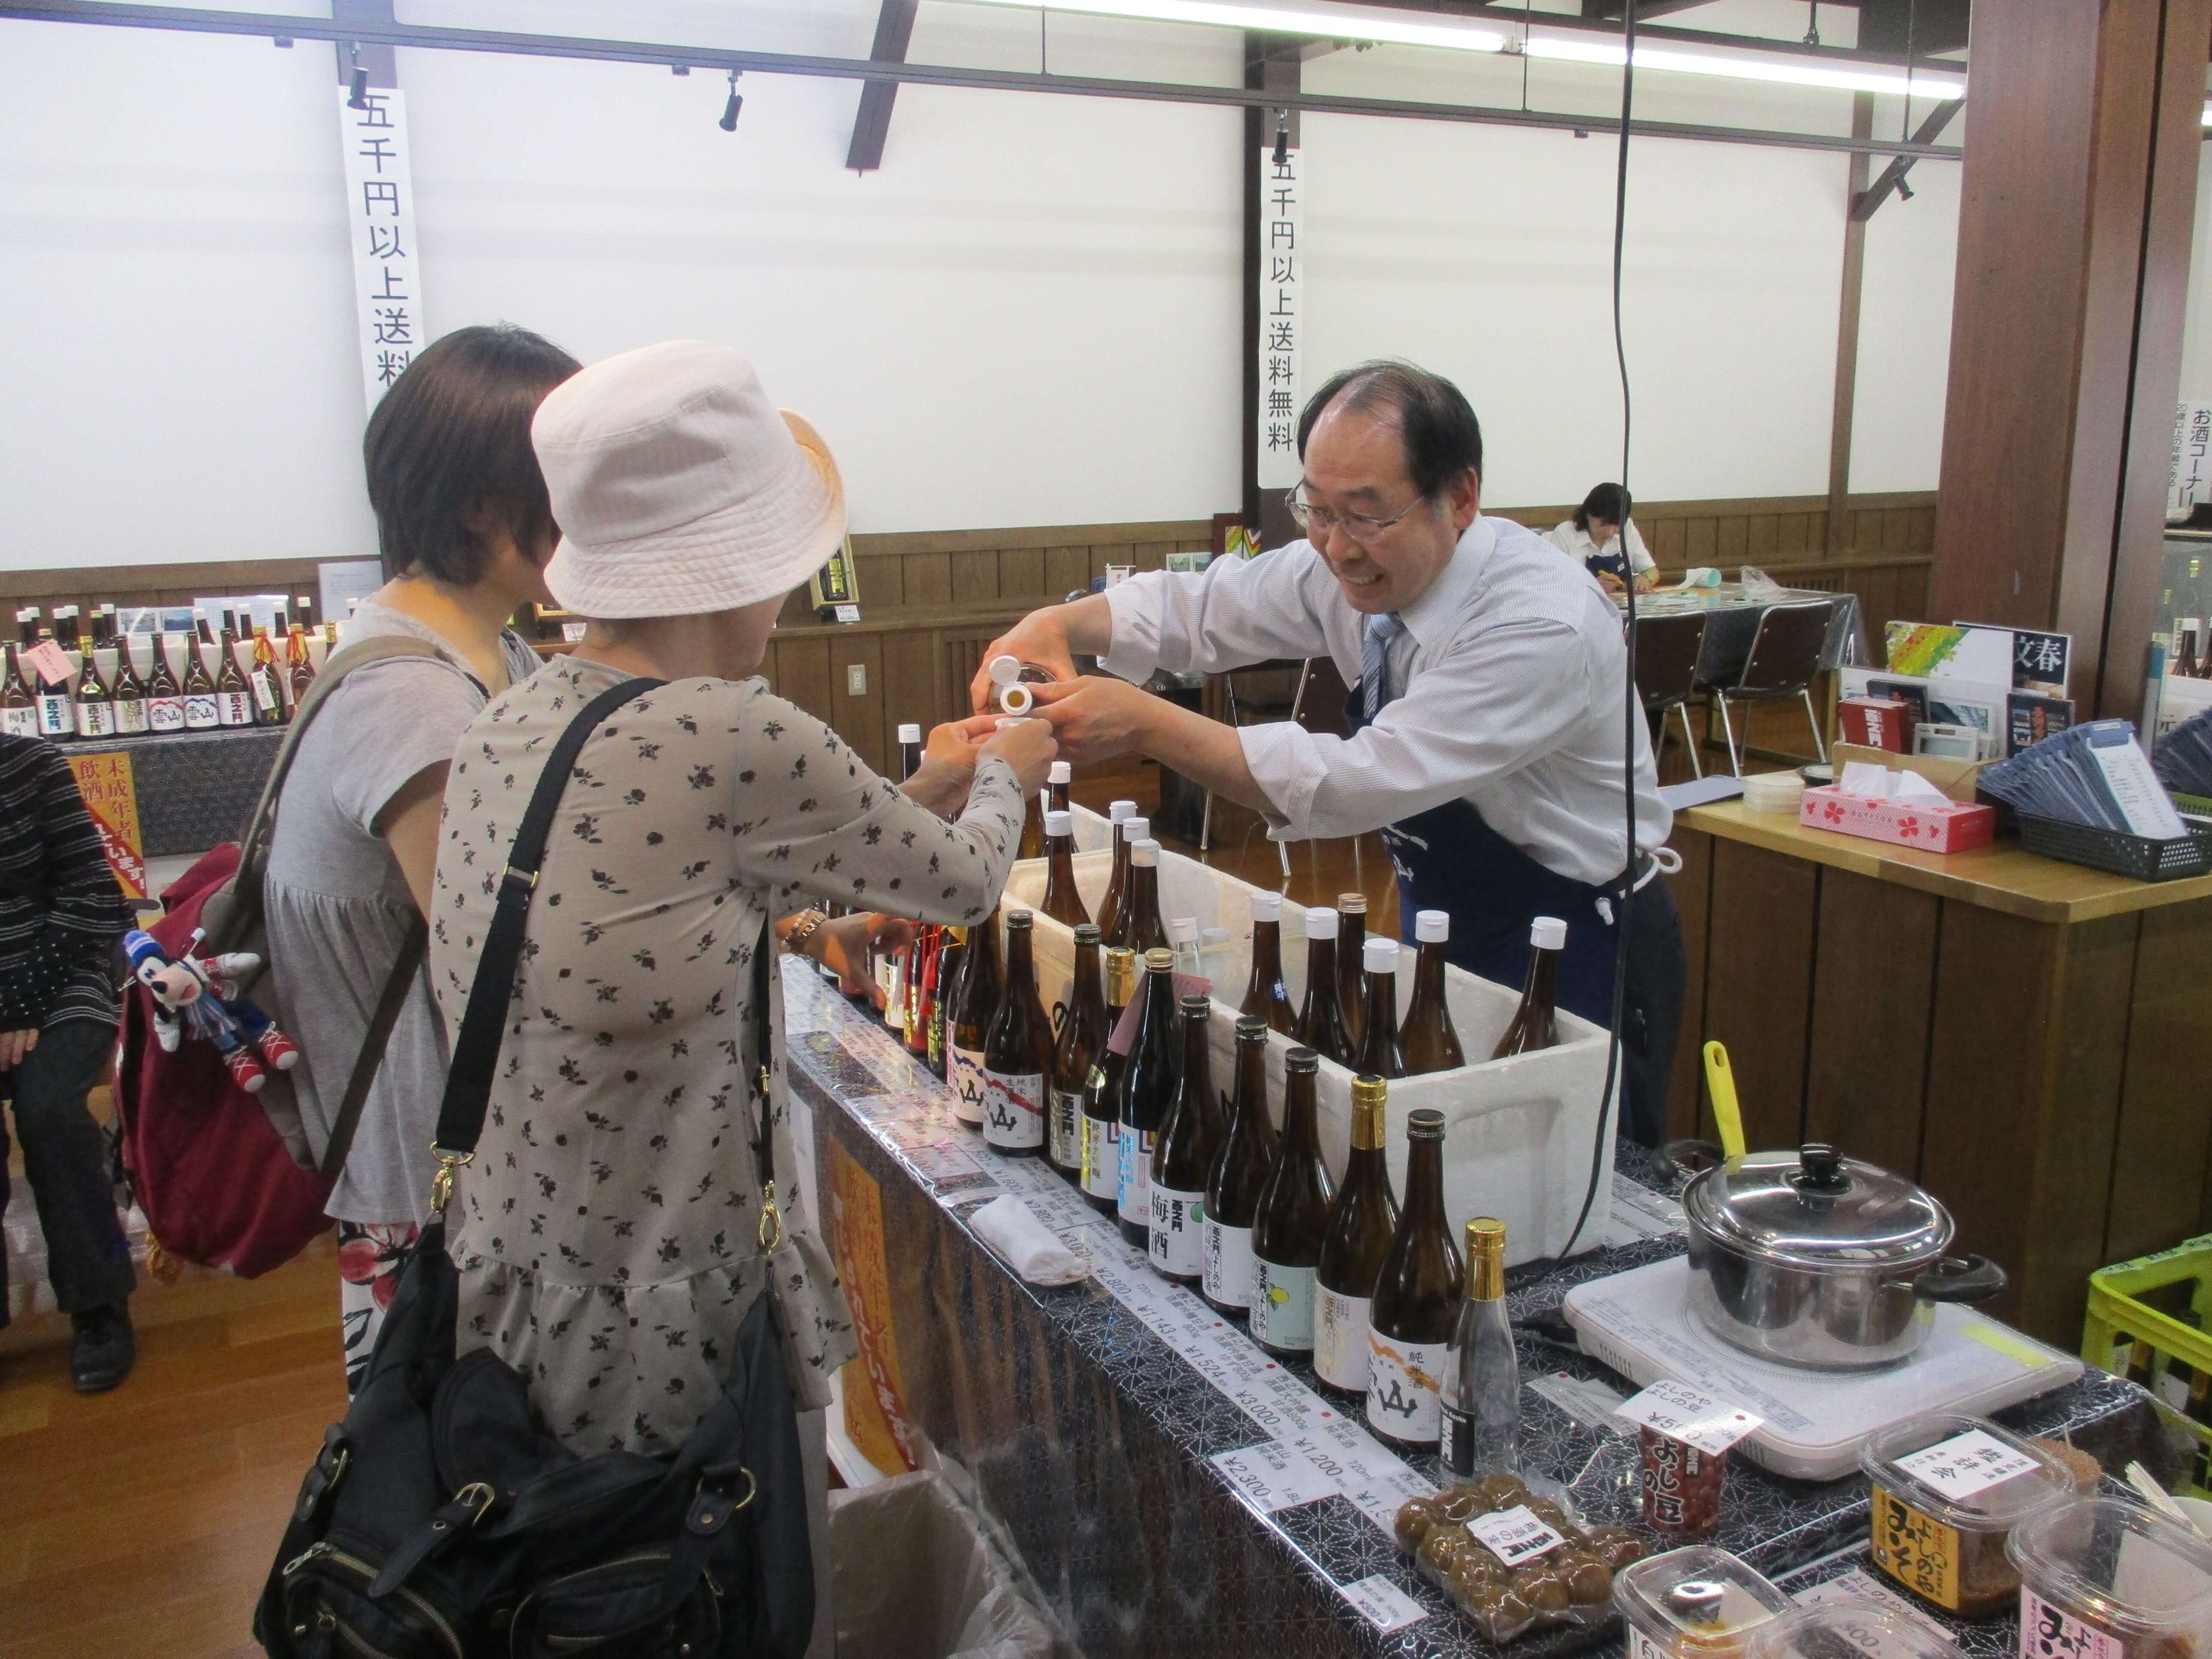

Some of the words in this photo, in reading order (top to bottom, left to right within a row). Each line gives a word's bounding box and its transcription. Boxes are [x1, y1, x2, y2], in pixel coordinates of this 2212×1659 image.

[1267, 154, 1296, 452] 五千円以上送料無料
[2185, 409, 2211, 507] お酒コーナー
[80, 760, 104, 802] 飲酒
[109, 759, 133, 839] 未成年者
[1152, 1191, 1169, 1259] 梅酒
[1177, 1292, 1205, 1310] 西之門
[1224, 1331, 1254, 1352] 西之門
[1408, 1351, 1425, 1389] 純米酒
[1276, 1374, 1308, 1396] 西之門
[1656, 1381, 1711, 1405] よしのや
[1646, 1388, 1704, 1413] よしの豆
[1324, 1425, 1357, 1449] 純米酒
[1255, 1445, 1288, 1470] 純米酒
[1931, 1447, 2004, 1479] 鑑評会
